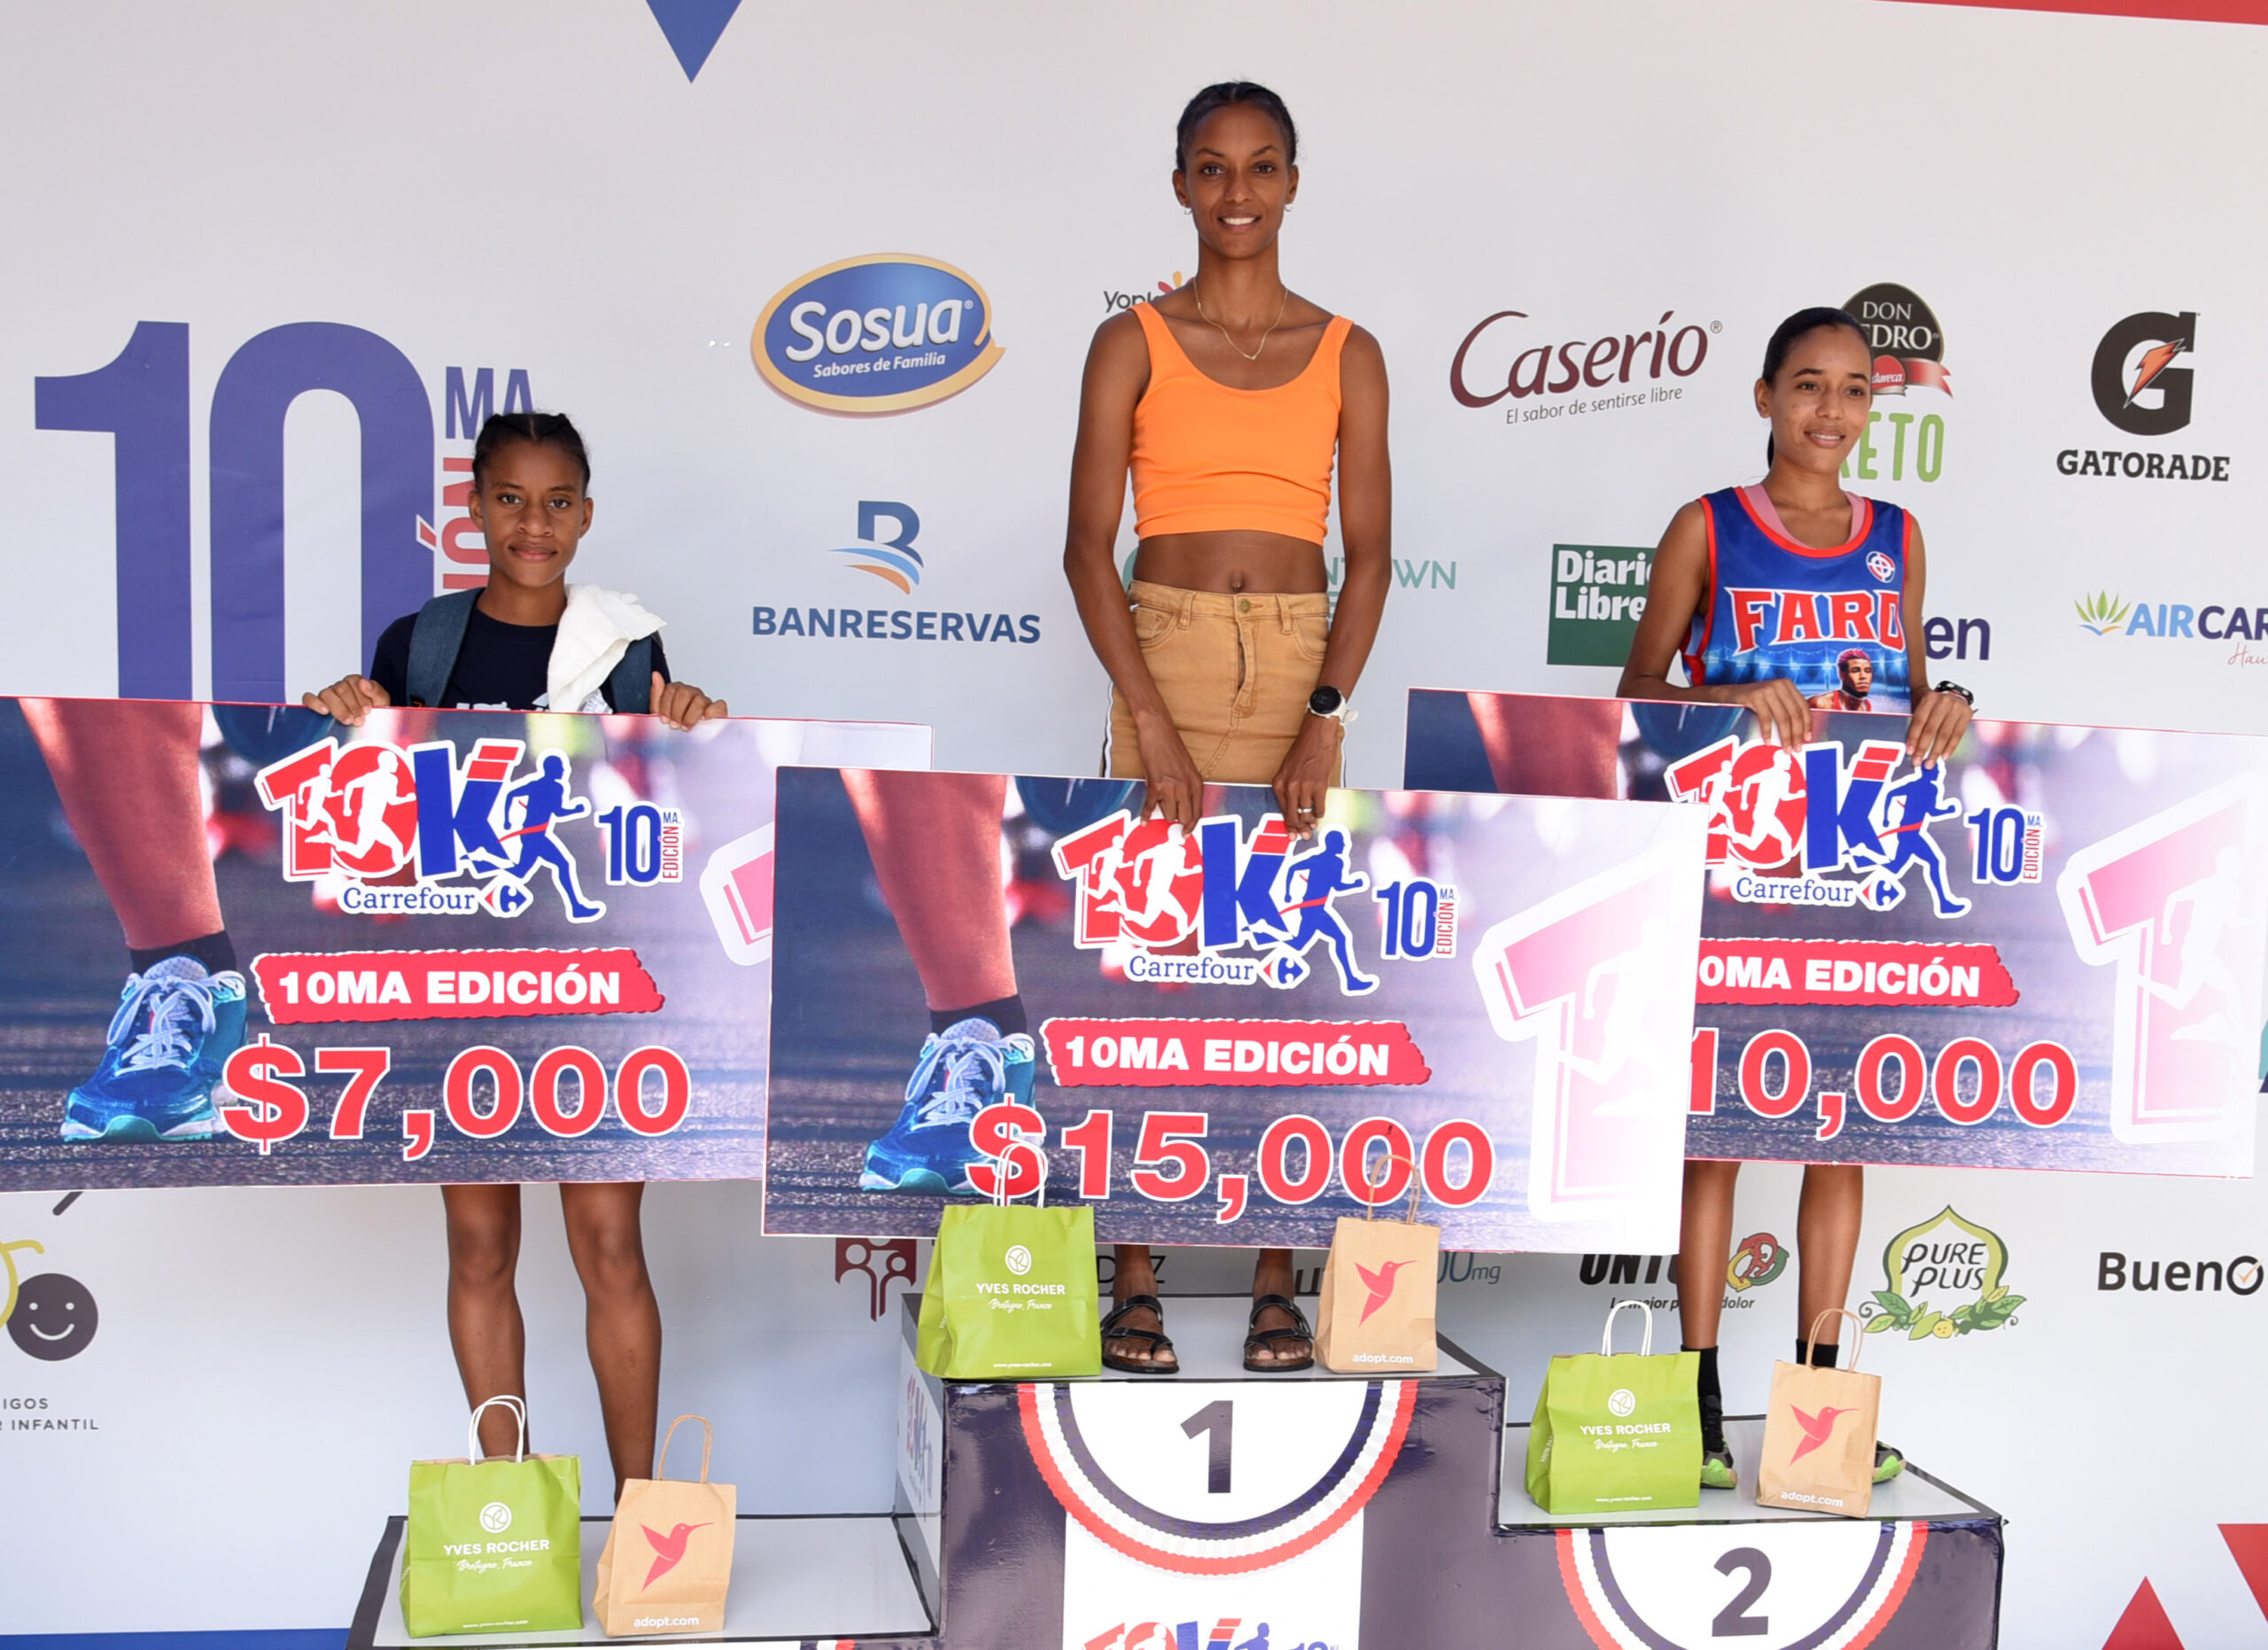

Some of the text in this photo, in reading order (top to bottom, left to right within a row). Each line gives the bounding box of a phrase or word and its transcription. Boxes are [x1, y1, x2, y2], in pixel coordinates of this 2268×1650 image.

[1862, 301, 1912, 320] DON
[786, 300, 963, 362] Sosua
[1860, 323, 1932, 350] DRO
[813, 352, 946, 378] Sabores de Familia
[1450, 310, 1709, 409] Caserío
[1871, 372, 1903, 384] duveca
[1506, 387, 1683, 424] El sabor de sentirse libre
[1840, 411, 1945, 482] ETO
[2056, 449, 2231, 482] GATORADE
[35, 321, 435, 706] 10
[1557, 549, 1652, 586] Diari
[1555, 586, 1647, 621] Libre
[751, 606, 1041, 645] BANRESERVAS
[599, 805, 662, 883] 10
[659, 826, 680, 879] EDICIÓN
[1968, 807, 2025, 882] 10
[2022, 829, 2040, 880] EDICIÓN
[343, 886, 476, 910] Carrefour
[1736, 877, 1854, 903] Carrefour
[1376, 881, 1438, 958] 10
[1435, 902, 1455, 954] EDICIÓN
[279, 964, 620, 1004] 10MA EDICIÓN
[1129, 955, 1254, 981] Carrefour
[1698, 955, 1980, 998] 0MA EDICIÓN
[1065, 1035, 1389, 1076] 10MA EDICIÓN
[221, 1033, 692, 1162] $7,000
[1687, 1026, 2079, 1141] 10,000
[966, 1094, 1496, 1224] $15,000
[1899, 1242, 1987, 1274] PURE
[975, 1283, 1067, 1296] YVES ROCHER
[1909, 1266, 1987, 1297] PLUS
[1721, 1296, 1755, 1309] dolor
[1352, 1351, 1414, 1366] adopt.com
[3, 1397, 49, 1410] IGOS
[12, 1418, 99, 1430] INFANTIL
[1580, 1422, 1672, 1436] YVES ROCHER
[1180, 1400, 1233, 1494] 1
[1780, 1490, 1844, 1507] adopt.com
[443, 1539, 550, 1555] YVES ROCHER
[1712, 1546, 1772, 1638] 2
[633, 1615, 700, 1629] adopt.com
